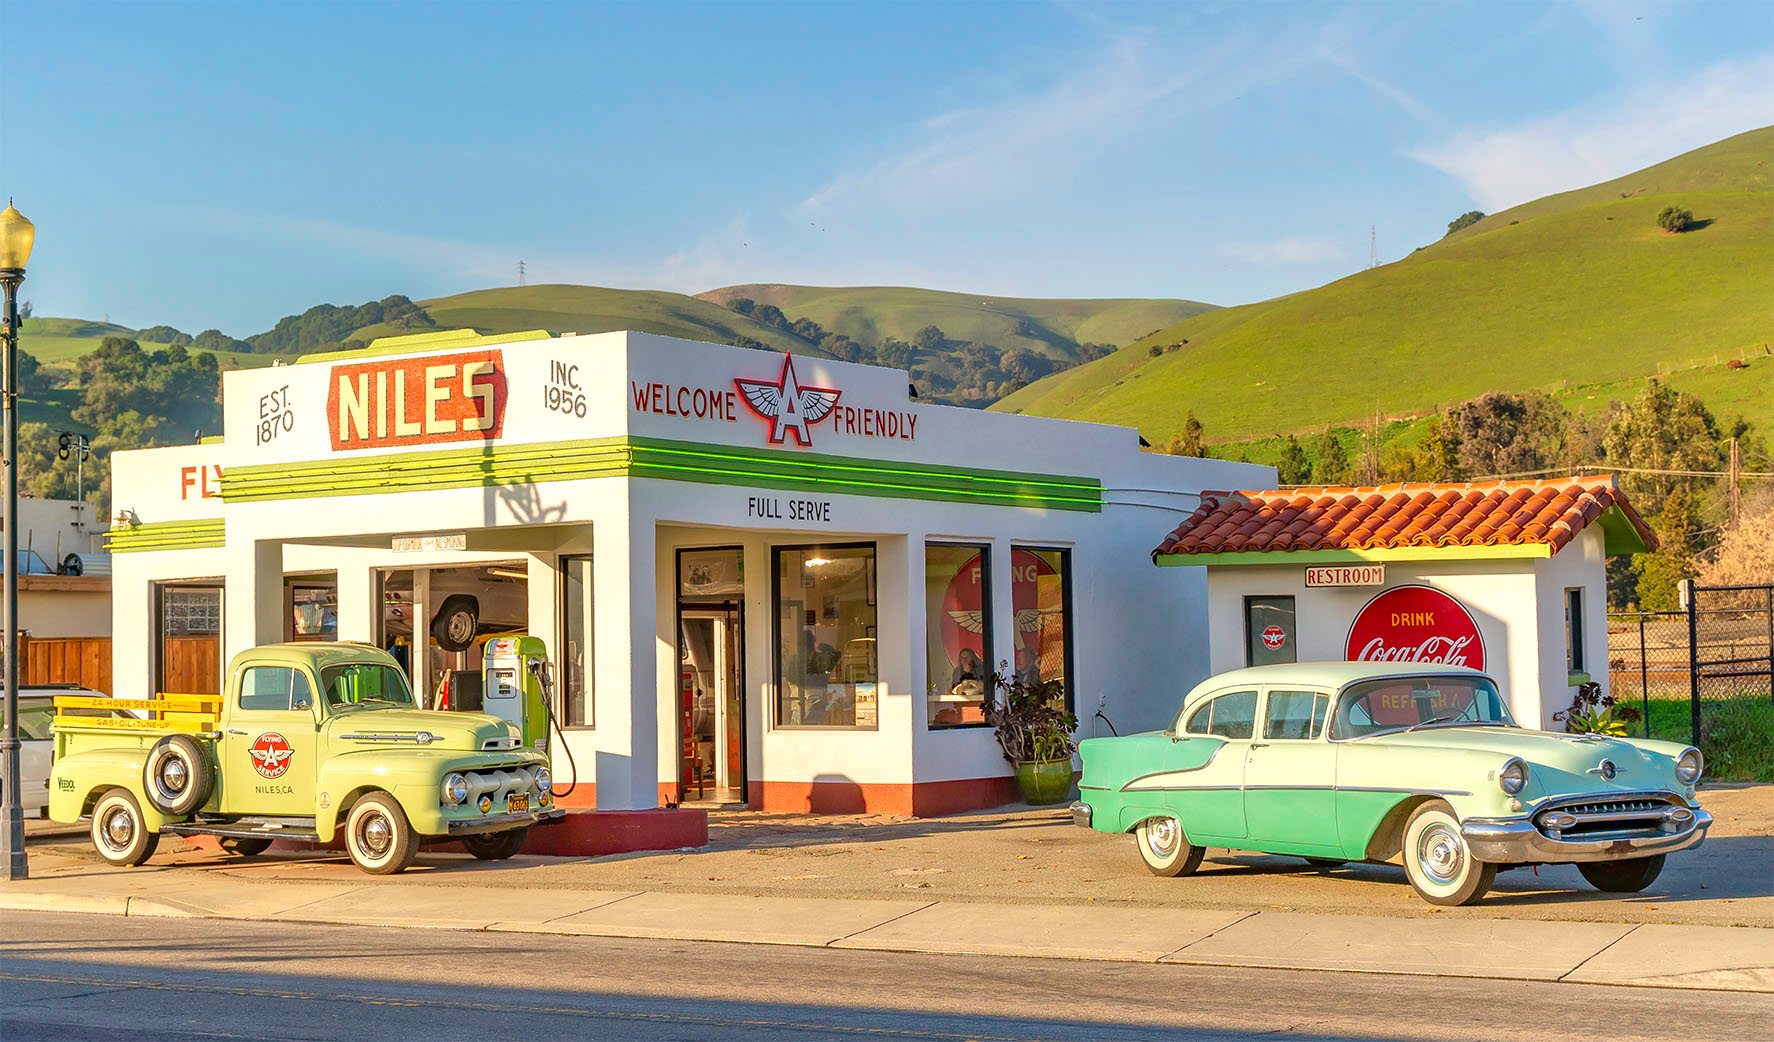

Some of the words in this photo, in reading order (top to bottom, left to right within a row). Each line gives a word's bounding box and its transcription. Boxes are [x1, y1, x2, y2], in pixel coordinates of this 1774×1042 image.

[551, 359, 582, 392] INC.
[260, 384, 291, 420] EST.
[339, 361, 495, 443] NILES
[544, 384, 587, 418] 1956
[632, 381, 737, 421] WELCOME
[834, 405, 918, 440] FRIENDLY
[257, 410, 293, 446] 1870
[748, 497, 782, 519] FULL
[789, 499, 831, 522] SERVE
[1308, 567, 1383, 585] RESTROOM
[1391, 612, 1435, 627] DRINK
[92, 698, 103, 707] 24
[107, 699, 131, 709] HOUR
[134, 700, 173, 710] SERVICE
[263, 743, 279, 767] A
[257, 765, 285, 777] SERVICE
